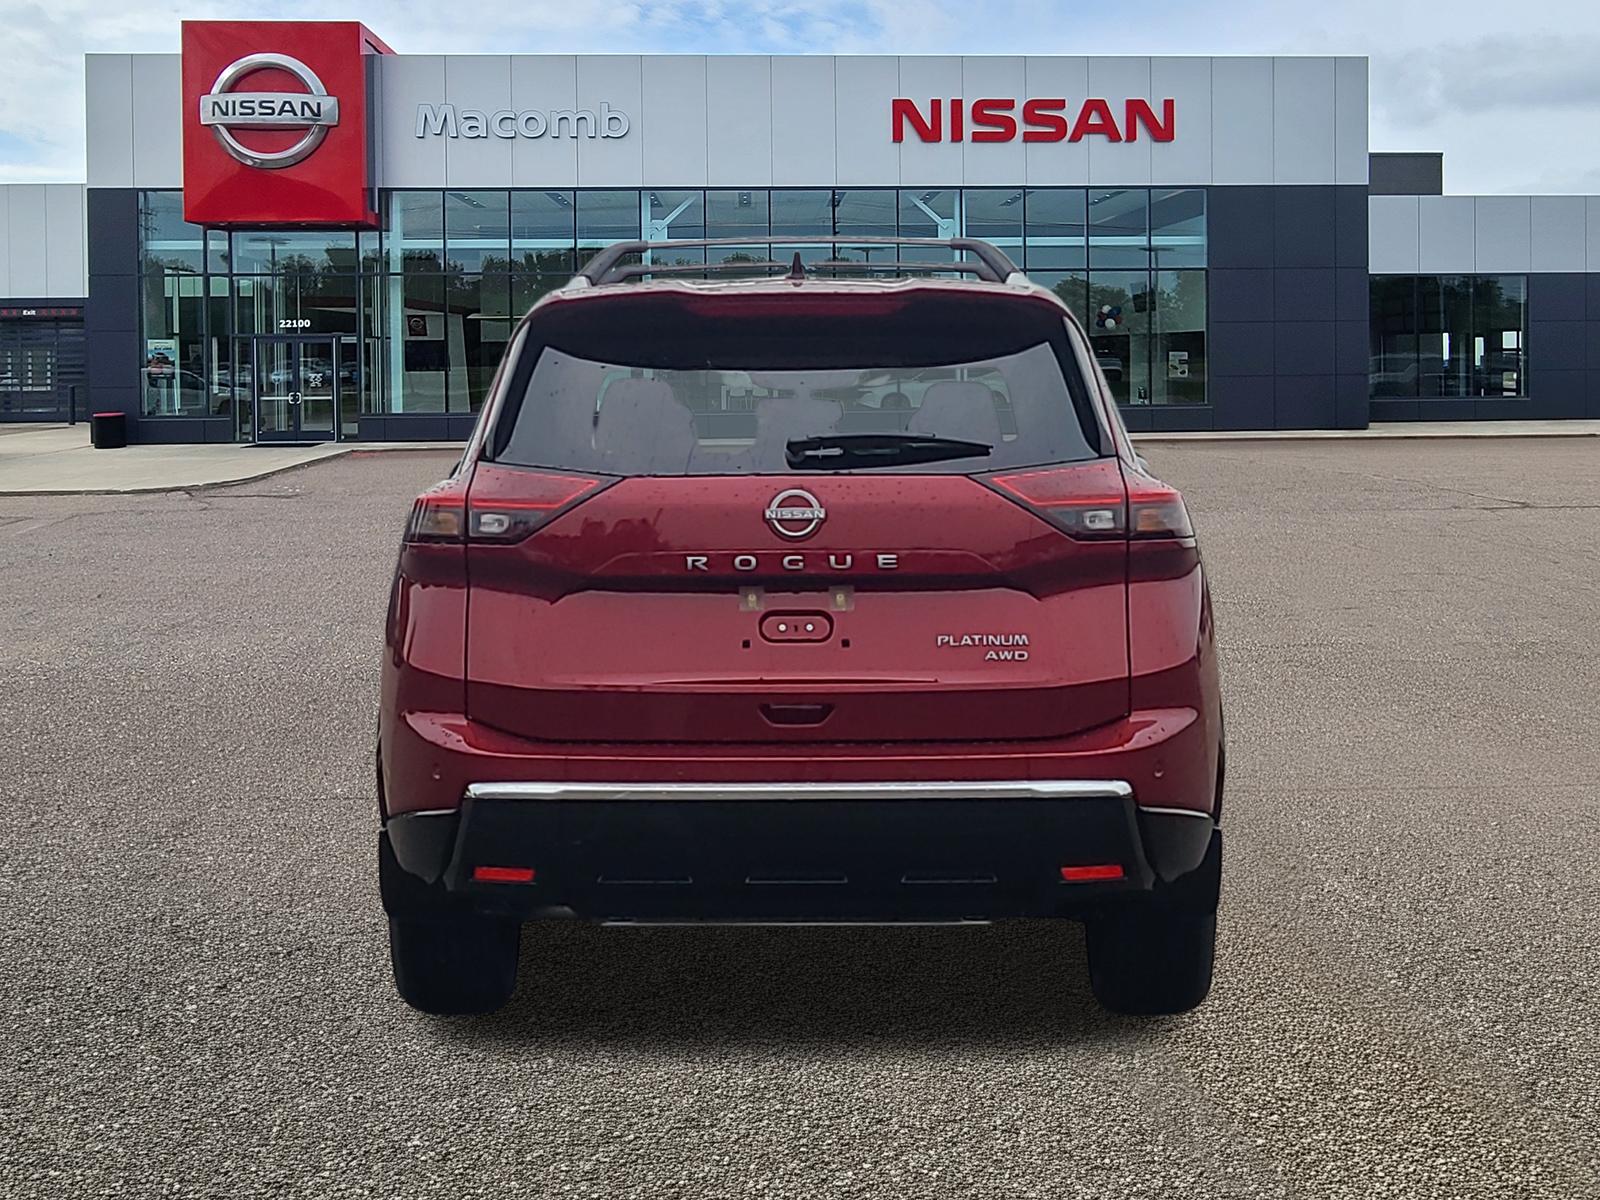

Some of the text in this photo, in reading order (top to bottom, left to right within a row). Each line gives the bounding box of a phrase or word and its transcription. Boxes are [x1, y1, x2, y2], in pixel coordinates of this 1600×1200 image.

[211, 100, 322, 118] NISSAN
[415, 101, 630, 139] Macomb
[891, 98, 1175, 142] NISSAN
[279, 319, 311, 328] 22100
[766, 509, 825, 519] NISSAN
[686, 554, 899, 571] ROGUE
[936, 634, 1030, 647] PLATINUM
[984, 650, 1029, 661] AWD
